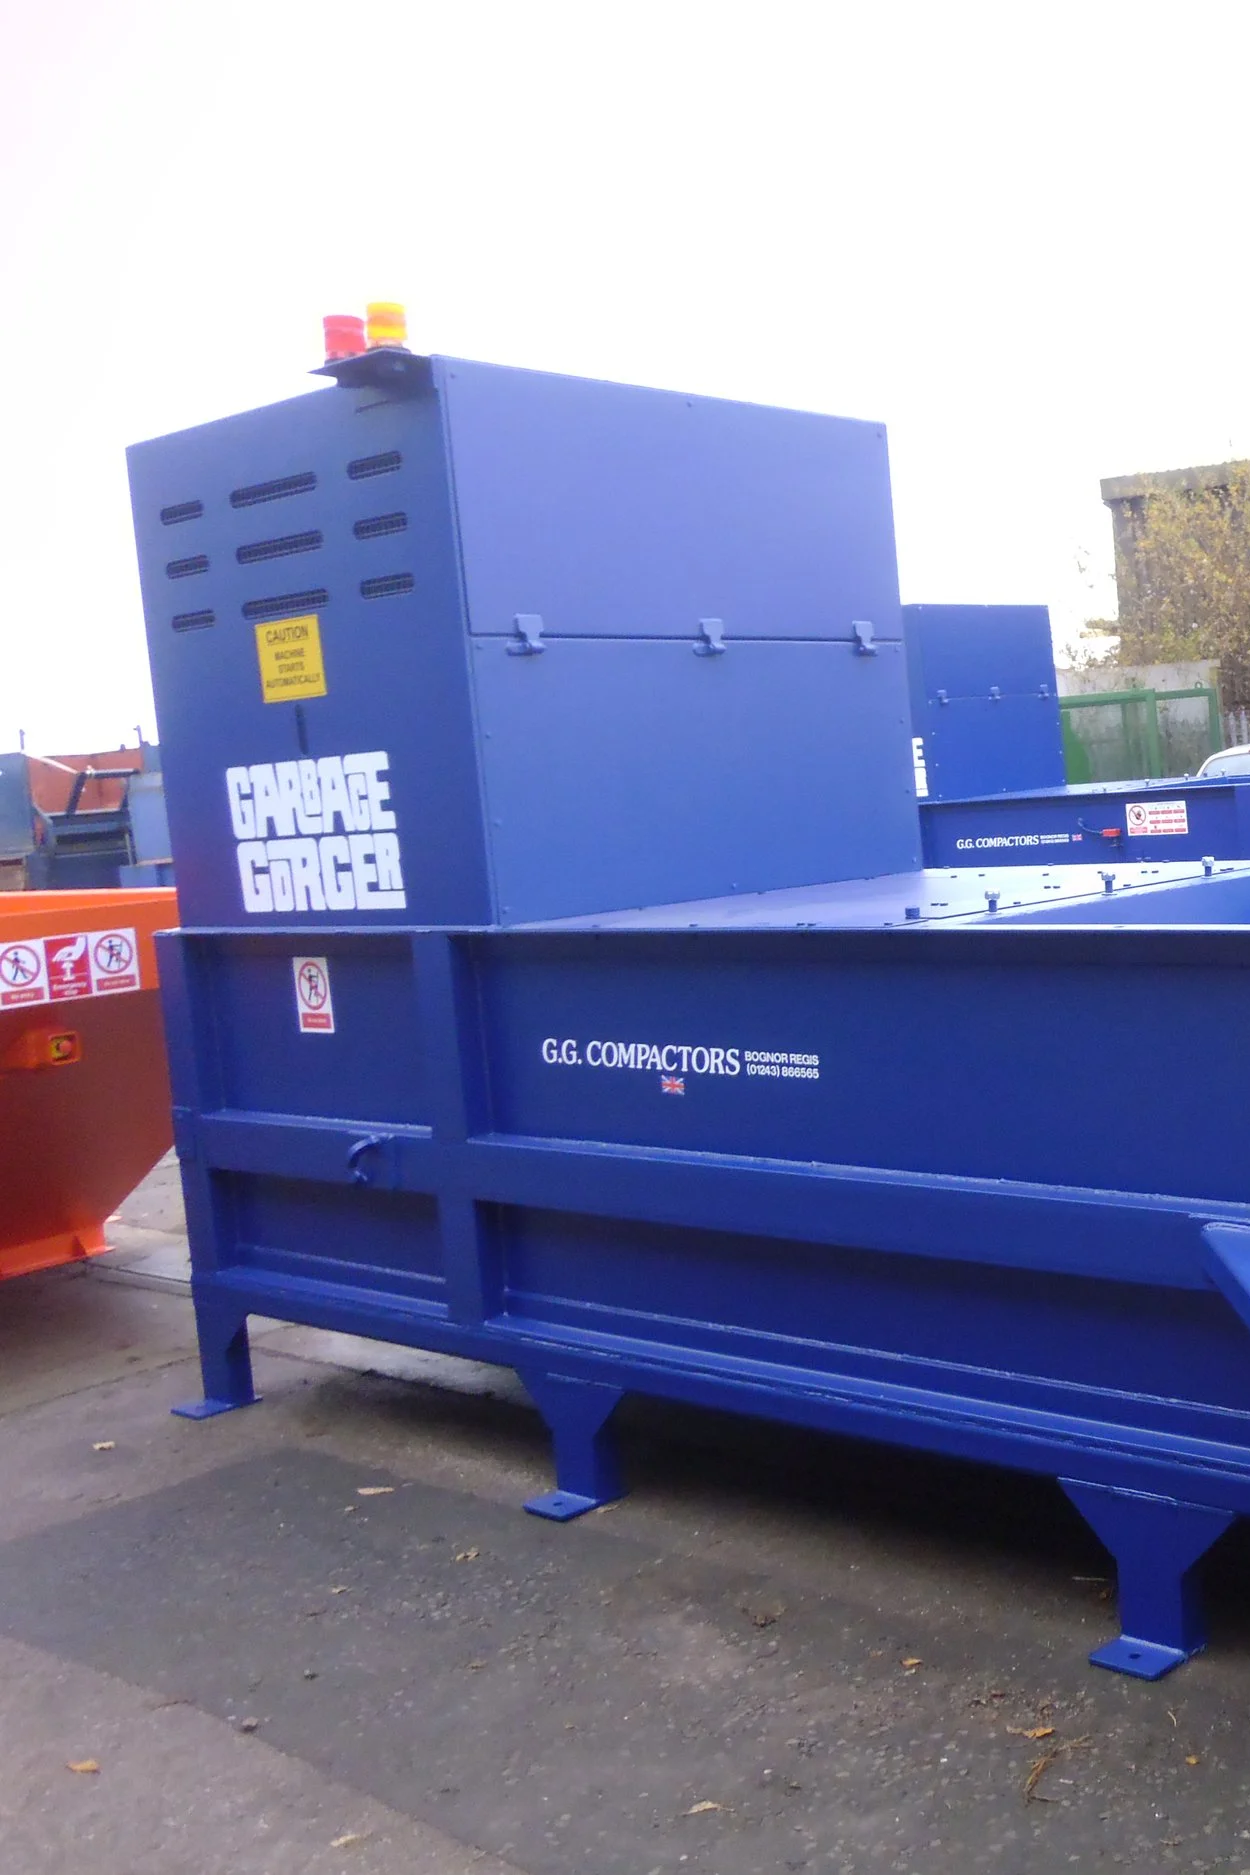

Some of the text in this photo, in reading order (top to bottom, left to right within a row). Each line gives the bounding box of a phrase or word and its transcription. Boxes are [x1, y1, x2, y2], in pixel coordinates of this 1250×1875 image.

[266, 625, 308, 643] CAUTION
[275, 648, 304, 661] MACHINE
[279, 661, 304, 673] STARTS
[266, 673, 320, 688] AUTOMATICALLY
[226, 751, 396, 840] GARBAGE
[976, 835, 1040, 848] COMPACTORS
[237, 832, 407, 913] GORGER
[542, 1038, 741, 1076] G.G. COMPACTORS
[745, 1050, 819, 1066] BOGNOR REGIS
[746, 1064, 819, 1080] (01243) 866565
